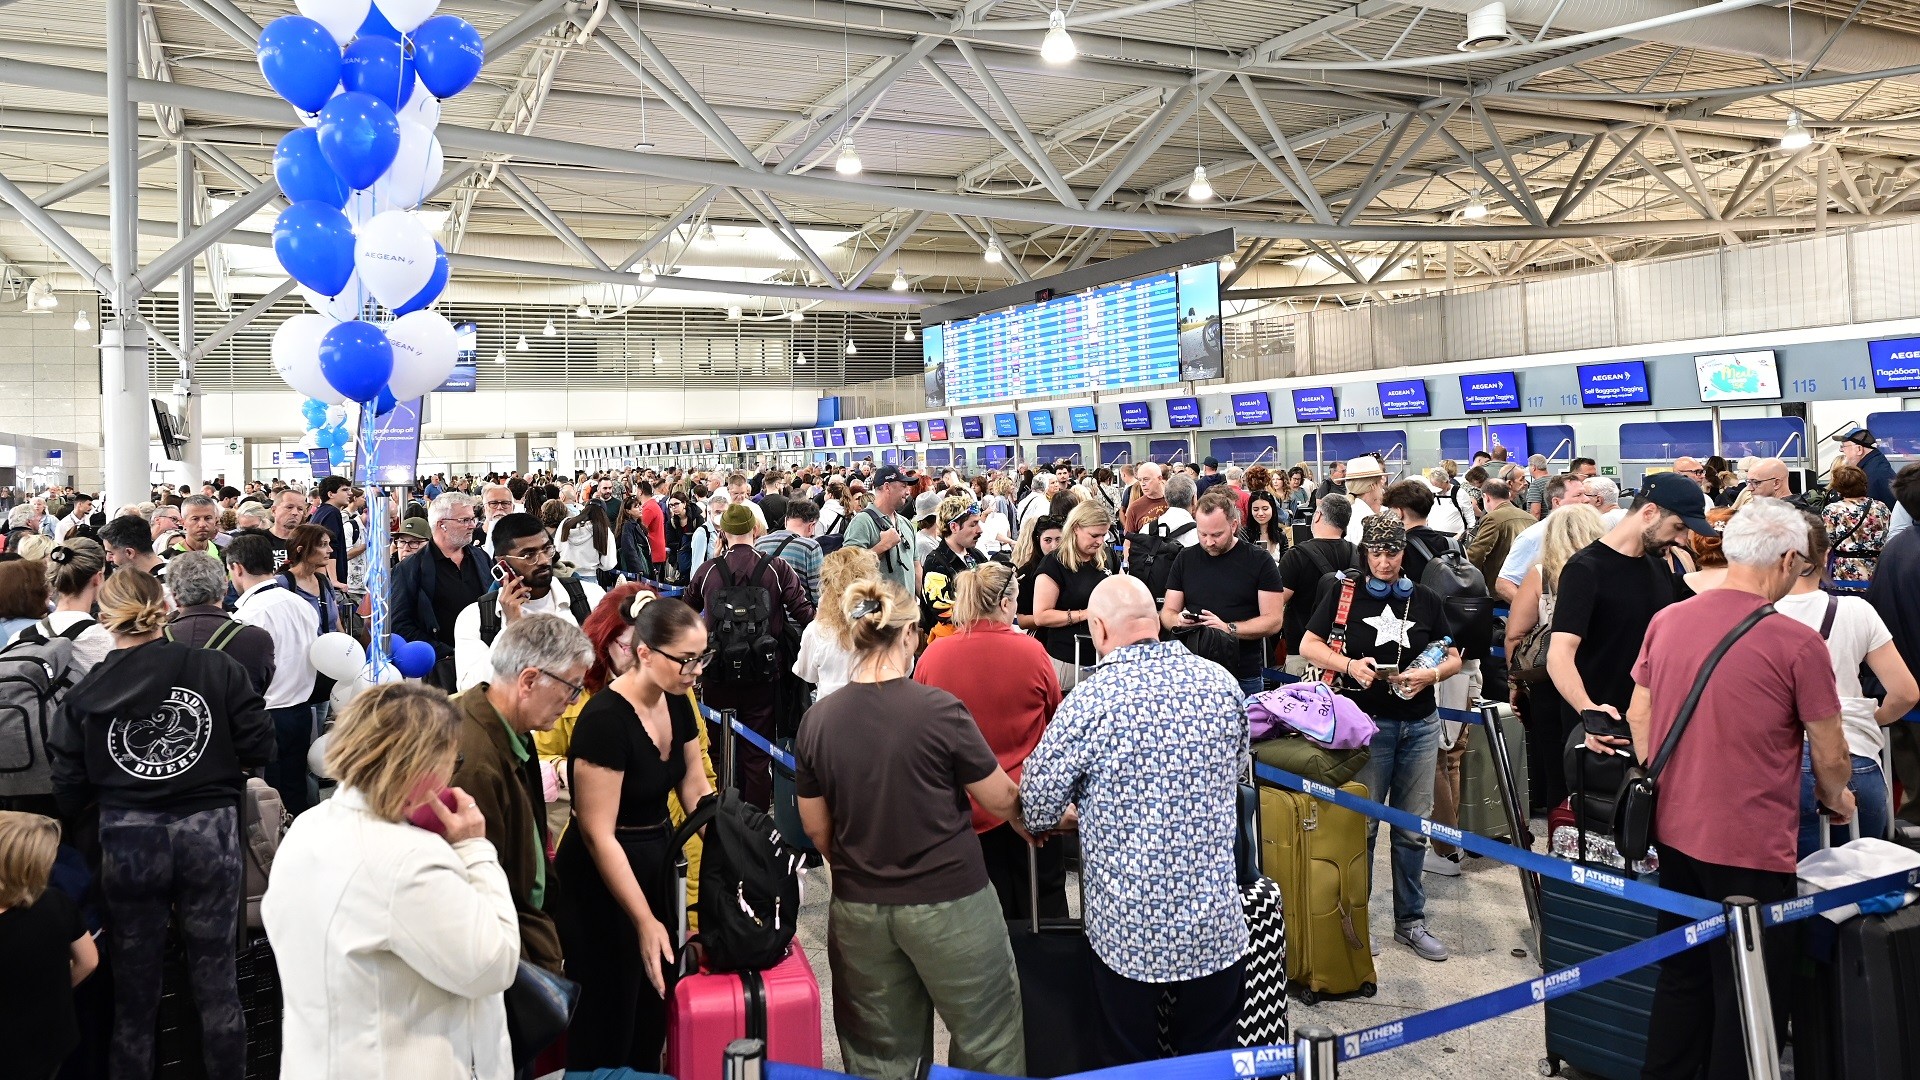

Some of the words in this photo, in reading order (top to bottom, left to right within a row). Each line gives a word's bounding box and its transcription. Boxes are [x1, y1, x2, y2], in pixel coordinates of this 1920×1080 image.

[365, 252, 406, 262] AEGEAN
[389, 338, 415, 352] GEAN
[1890, 351, 1920, 360] AEGE
[1592, 374, 1624, 382] AEGEAN
[1876, 367, 1920, 377] Παράδοση
[1595, 387, 1620, 395] Baggage
[1620, 386, 1644, 394] Tagging
[1792, 379, 1817, 393] 115
[1841, 376, 1867, 391] 114
[1527, 396, 1544, 408] 117
[1560, 394, 1578, 406] 116
[1343, 407, 1355, 417] 119
[1366, 407, 1380, 416] 118
[1205, 416, 1215, 425] 121
[1225, 415, 1235, 424] 120
[170, 690, 201, 707] END
[134, 750, 198, 775] DIVERS
[1311, 782, 1336, 796] ATHENS
[1431, 822, 1463, 838] ATHENS
[1585, 869, 1625, 887] ATHENS
[1783, 896, 1814, 912] ATHENS
[1696, 913, 1727, 932] ATHENS
[1544, 966, 1580, 988] ATHENS
[1360, 1021, 1403, 1043] ATHENS
[1255, 1046, 1295, 1063] ATHE
